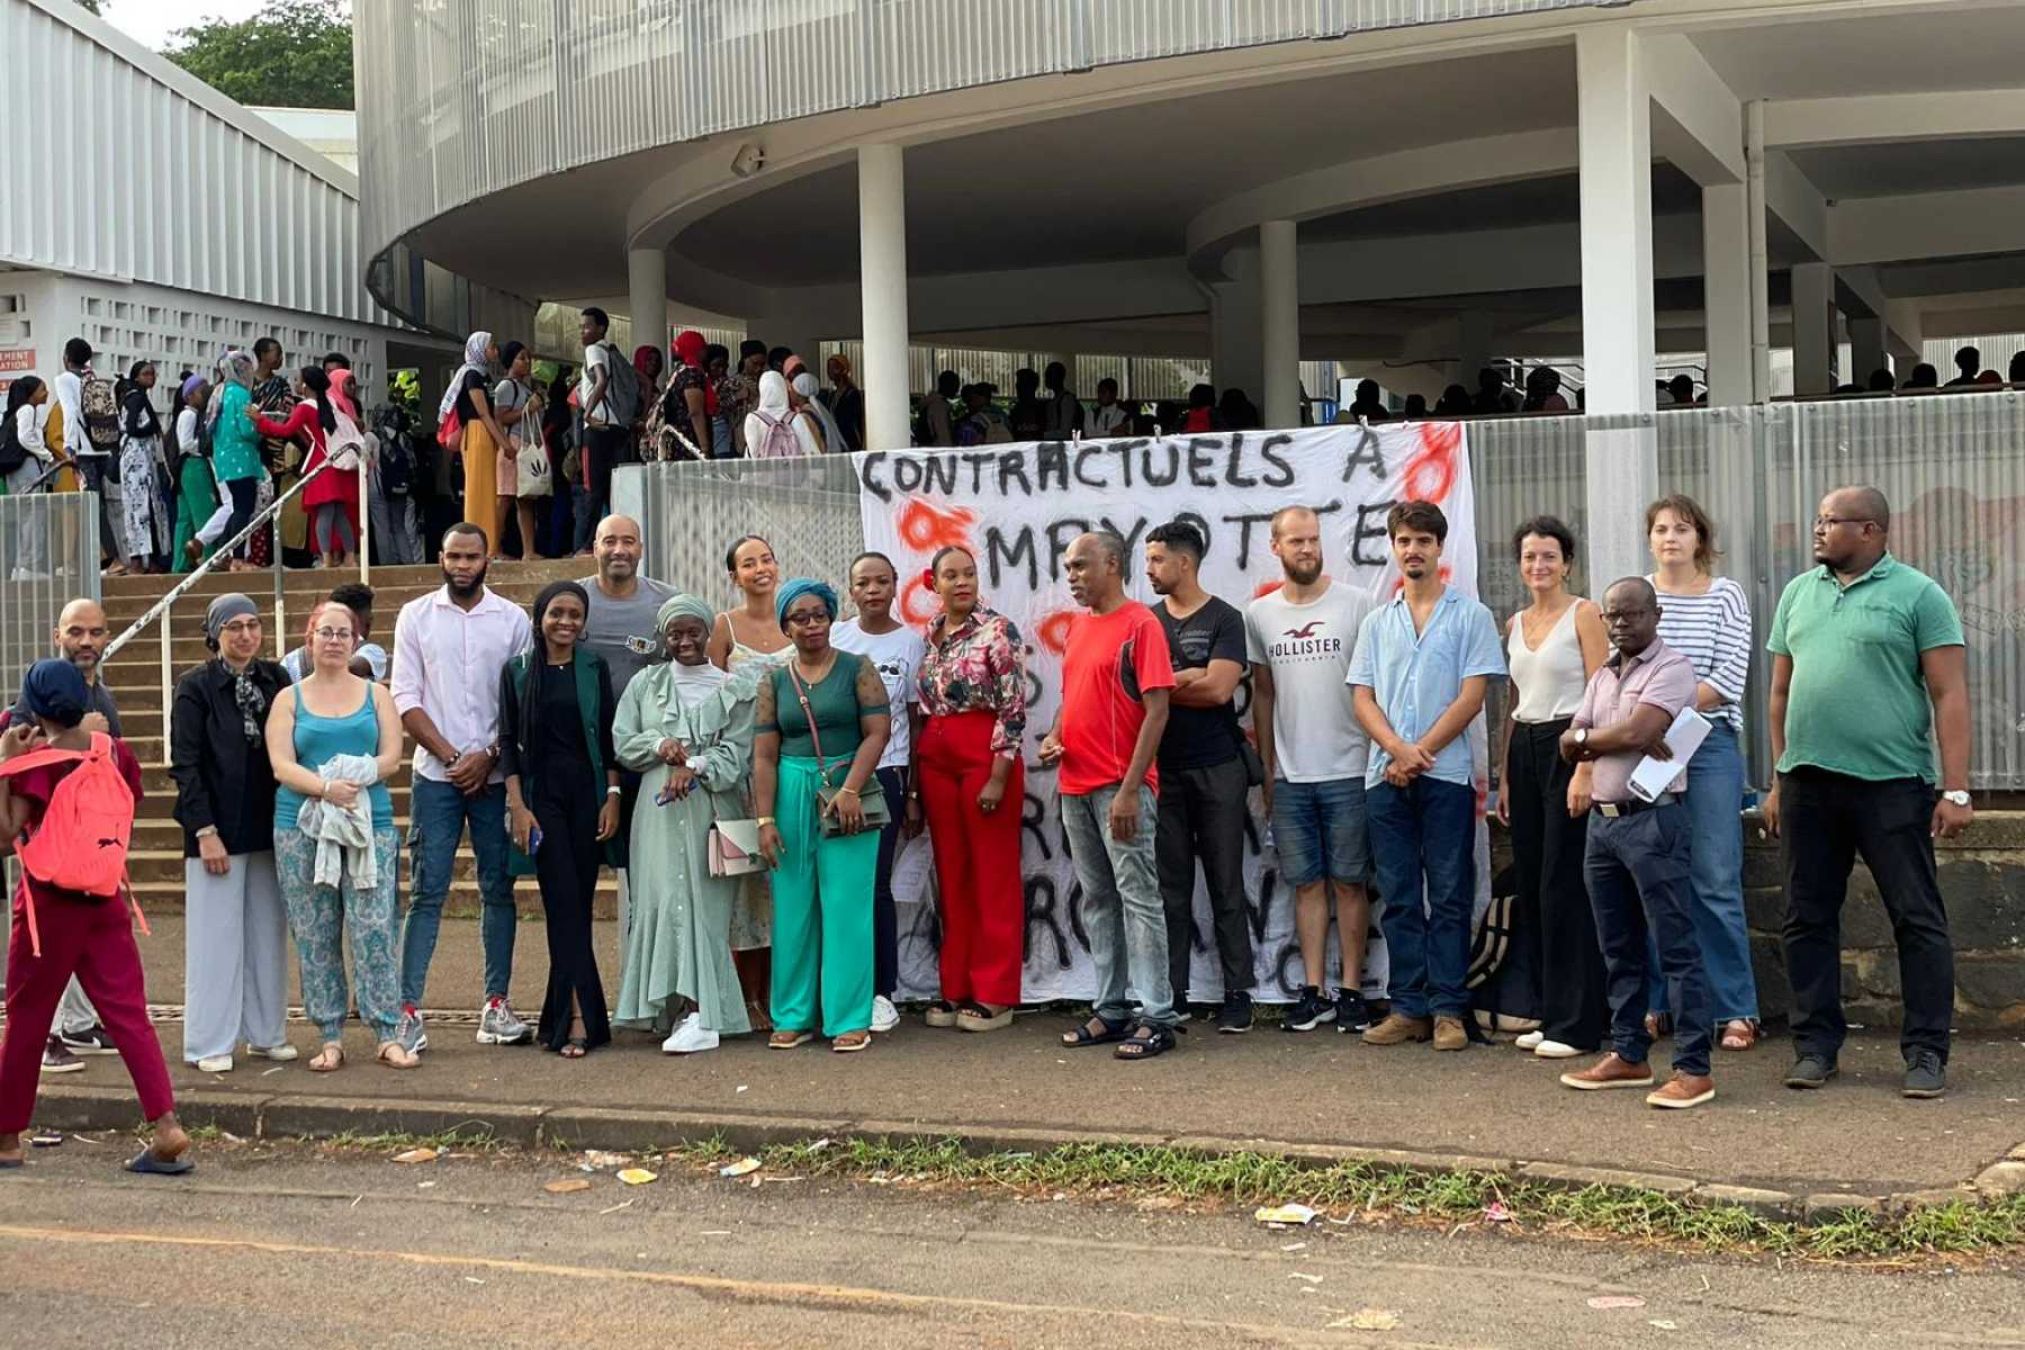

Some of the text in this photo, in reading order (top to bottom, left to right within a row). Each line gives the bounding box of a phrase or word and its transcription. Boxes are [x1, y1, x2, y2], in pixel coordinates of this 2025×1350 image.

[862, 427, 1388, 501] CONTRACTUELS A
[1268, 638, 1341, 657] HOLLISTER
